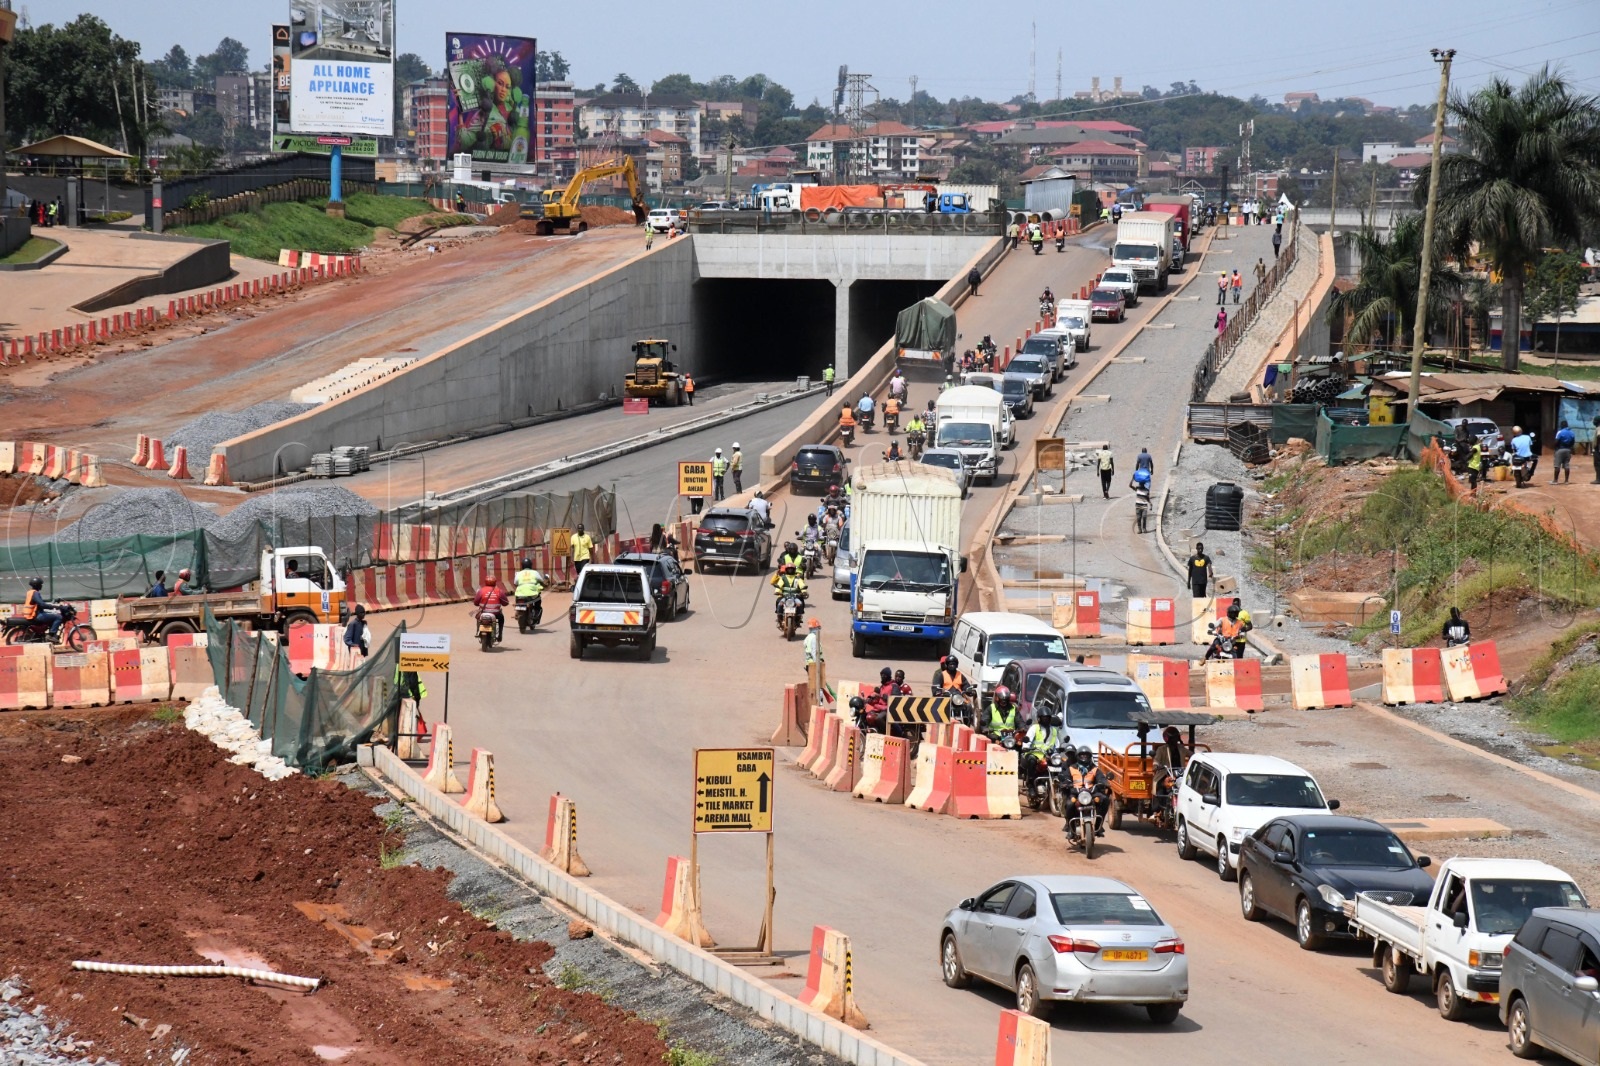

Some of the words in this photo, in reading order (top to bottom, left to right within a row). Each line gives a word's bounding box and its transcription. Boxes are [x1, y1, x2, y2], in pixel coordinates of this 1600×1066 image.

[314, 65, 333, 76] ALL
[336, 66, 370, 78] HOME
[309, 80, 375, 94] APPLIANCE
[684, 465, 706, 474] GABA
[737, 752, 772, 760] NSAMBYA
[737, 764, 756, 772] GABA
[706, 776, 732, 785] KIBULI
[705, 801, 720, 810] TILE
[722, 801, 754, 810] MARKET
[704, 814, 730, 823] ARENA
[732, 813, 751, 822] MALL
